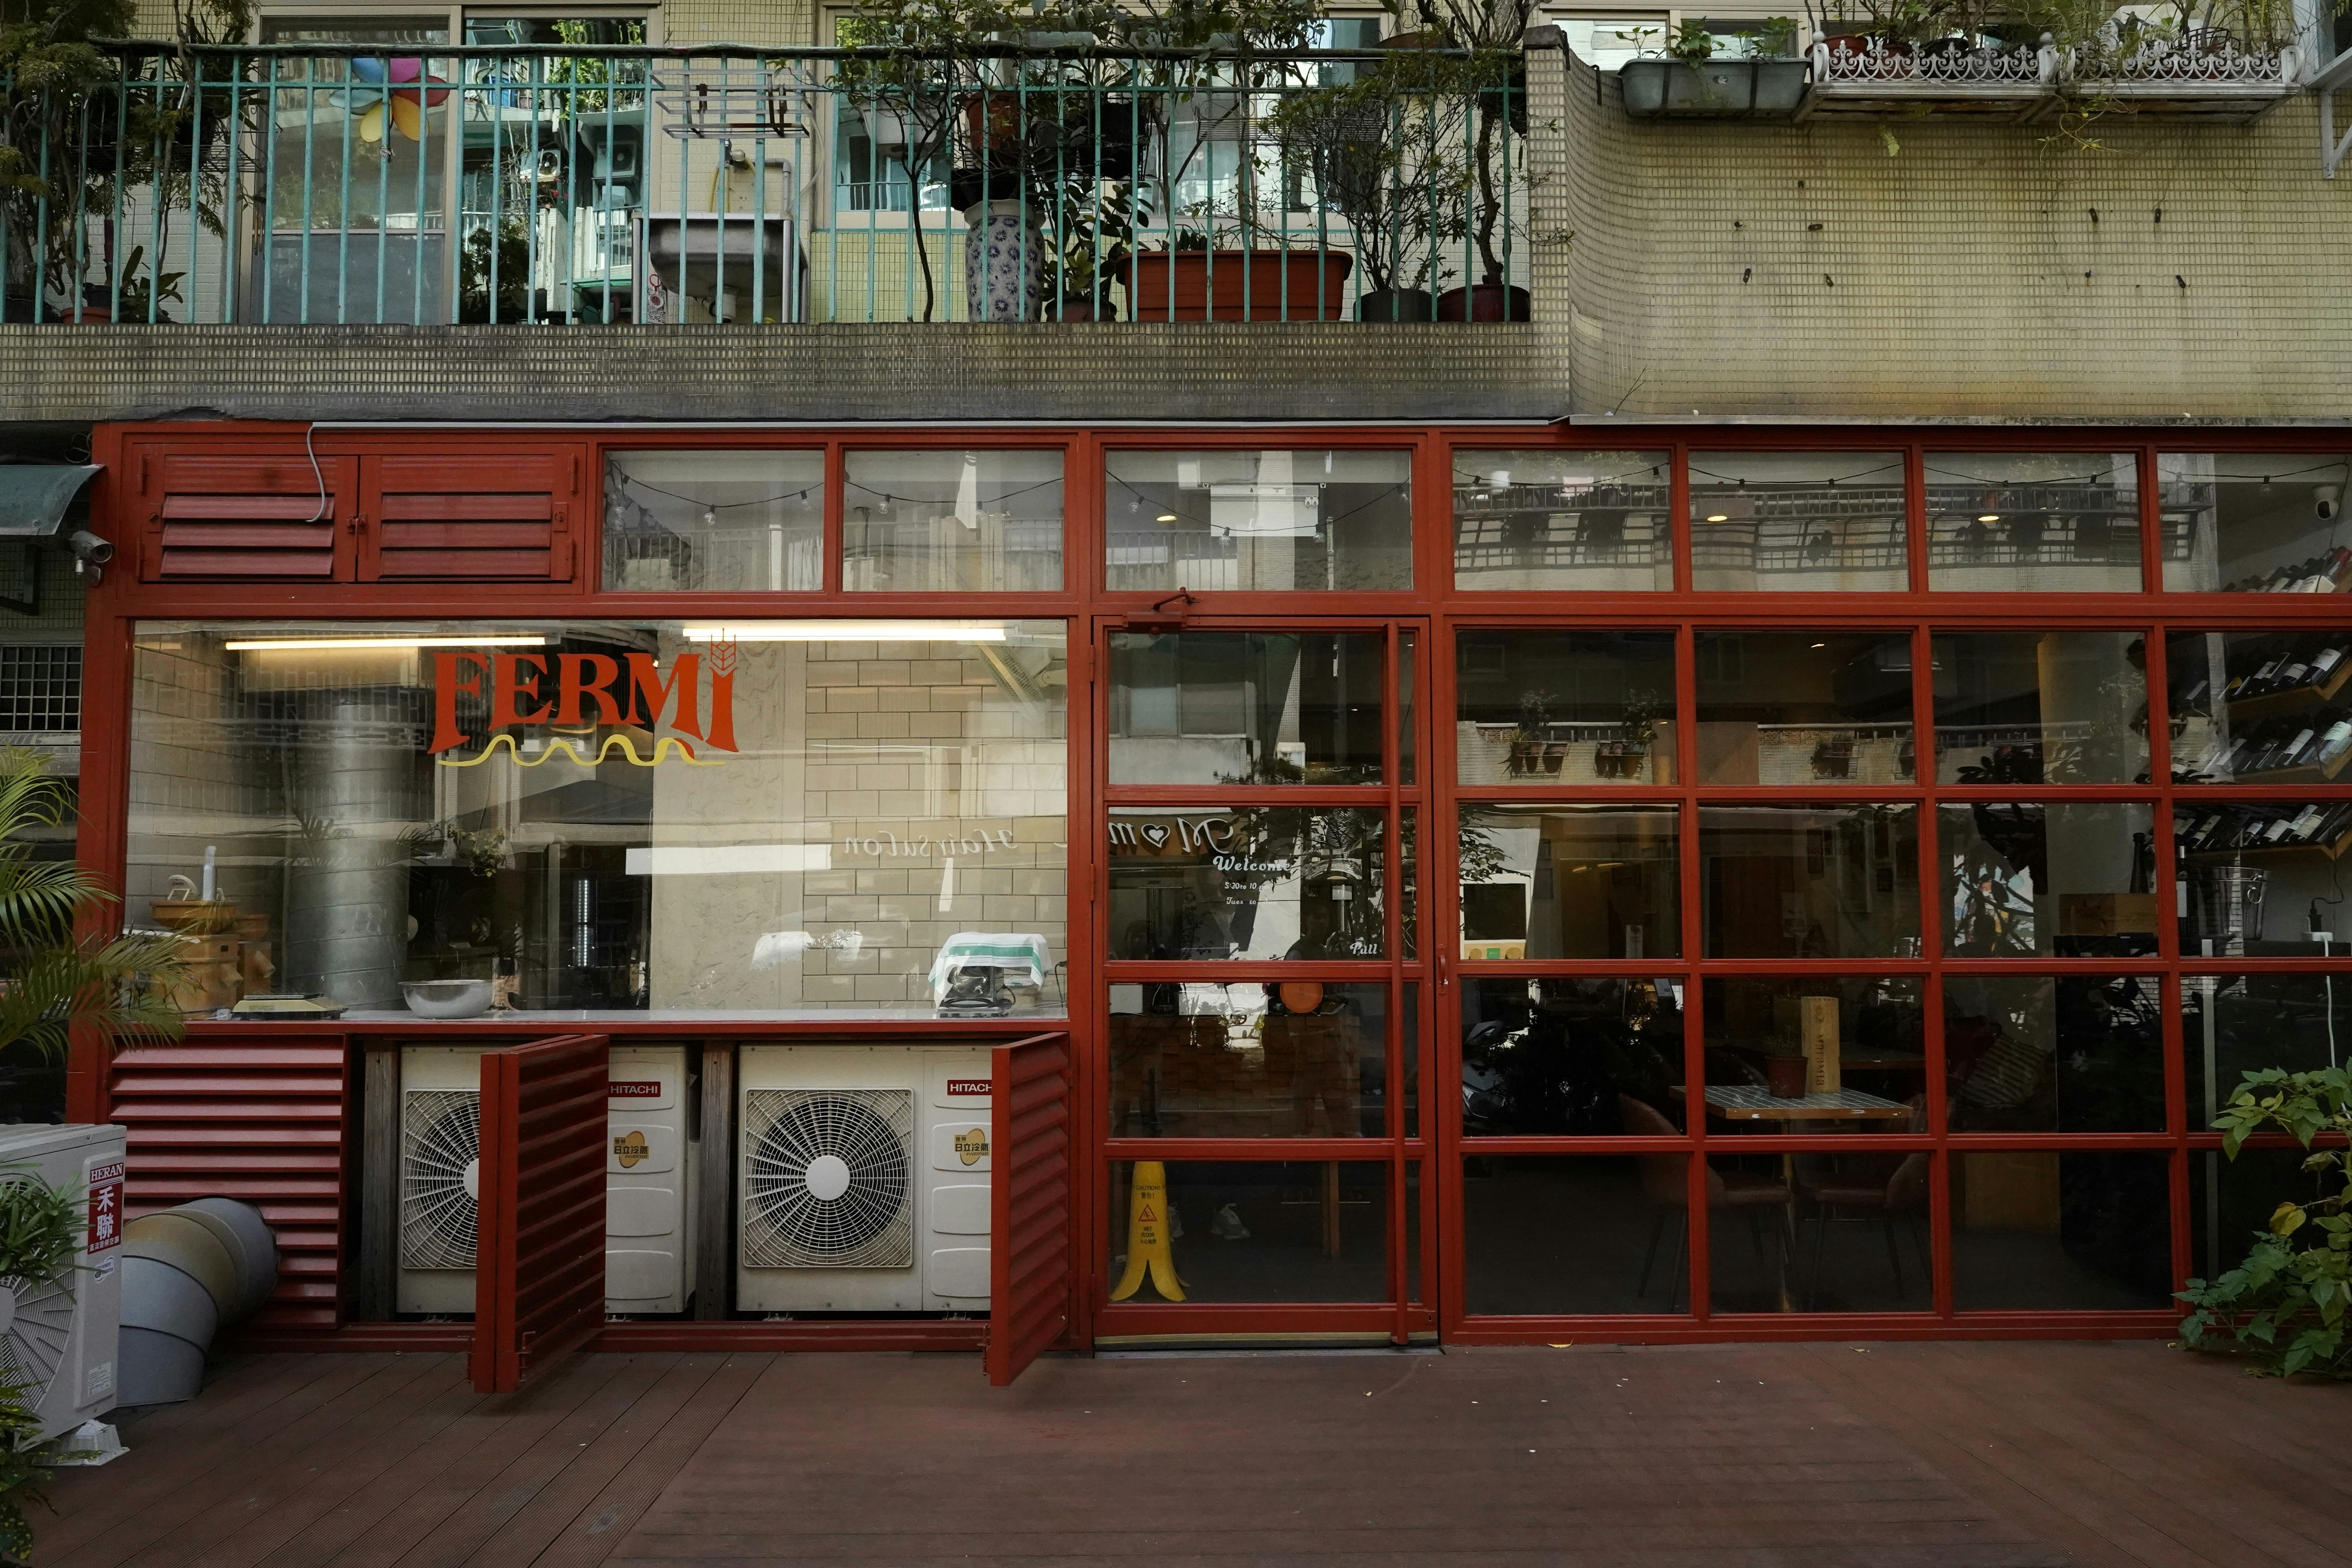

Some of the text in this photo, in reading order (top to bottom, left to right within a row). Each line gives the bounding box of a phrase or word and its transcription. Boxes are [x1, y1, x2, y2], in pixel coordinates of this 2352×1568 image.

[427, 651, 739, 753] FERMI
[1213, 856, 1291, 871] Welcome
[1350, 942, 1377, 955] Pull
[610, 1085, 658, 1094] HITACHI
[950, 1083, 992, 1092] HITACH
[614, 1145, 648, 1154] 日立冷氣
[955, 1143, 989, 1152] 日立冷氣
[91, 1163, 123, 1181] HERAN
